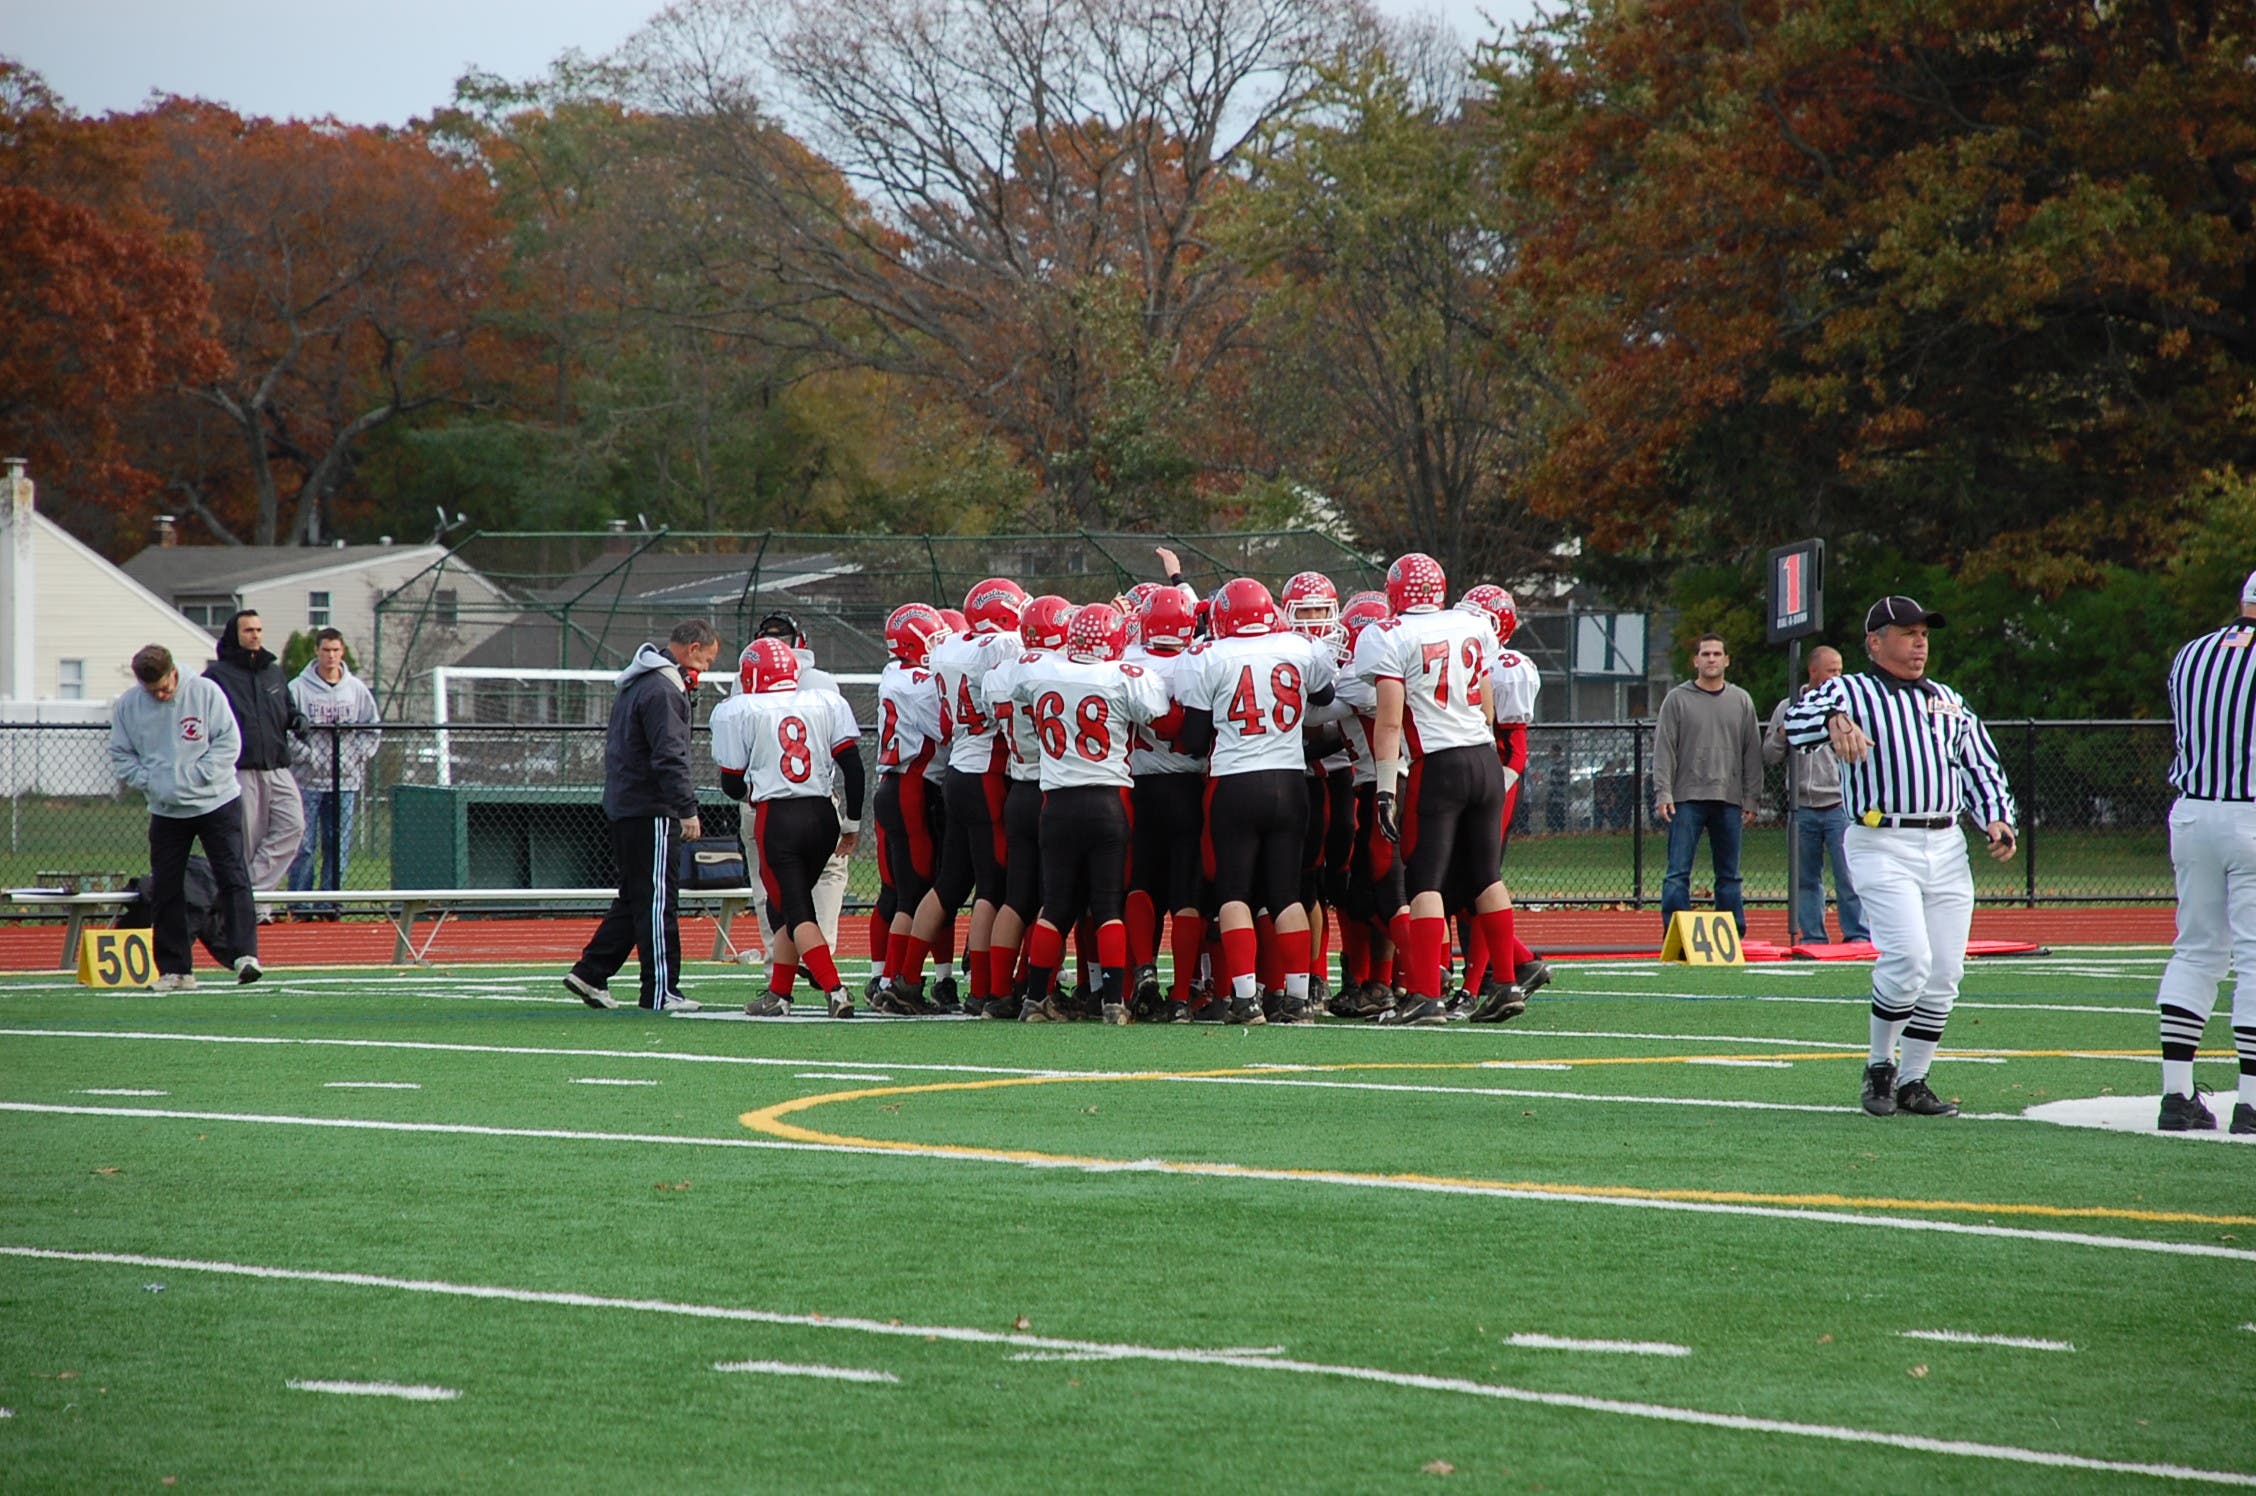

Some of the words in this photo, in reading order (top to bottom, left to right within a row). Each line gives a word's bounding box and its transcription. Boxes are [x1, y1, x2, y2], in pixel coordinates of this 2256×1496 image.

[1783, 553, 1800, 614] 1
[1227, 662, 1302, 735] 48
[1421, 637, 1483, 709] 72
[778, 716, 811, 783] 8
[1036, 691, 1111, 761] 68
[97, 934, 150, 985] 50
[1692, 916, 1736, 963] 40
